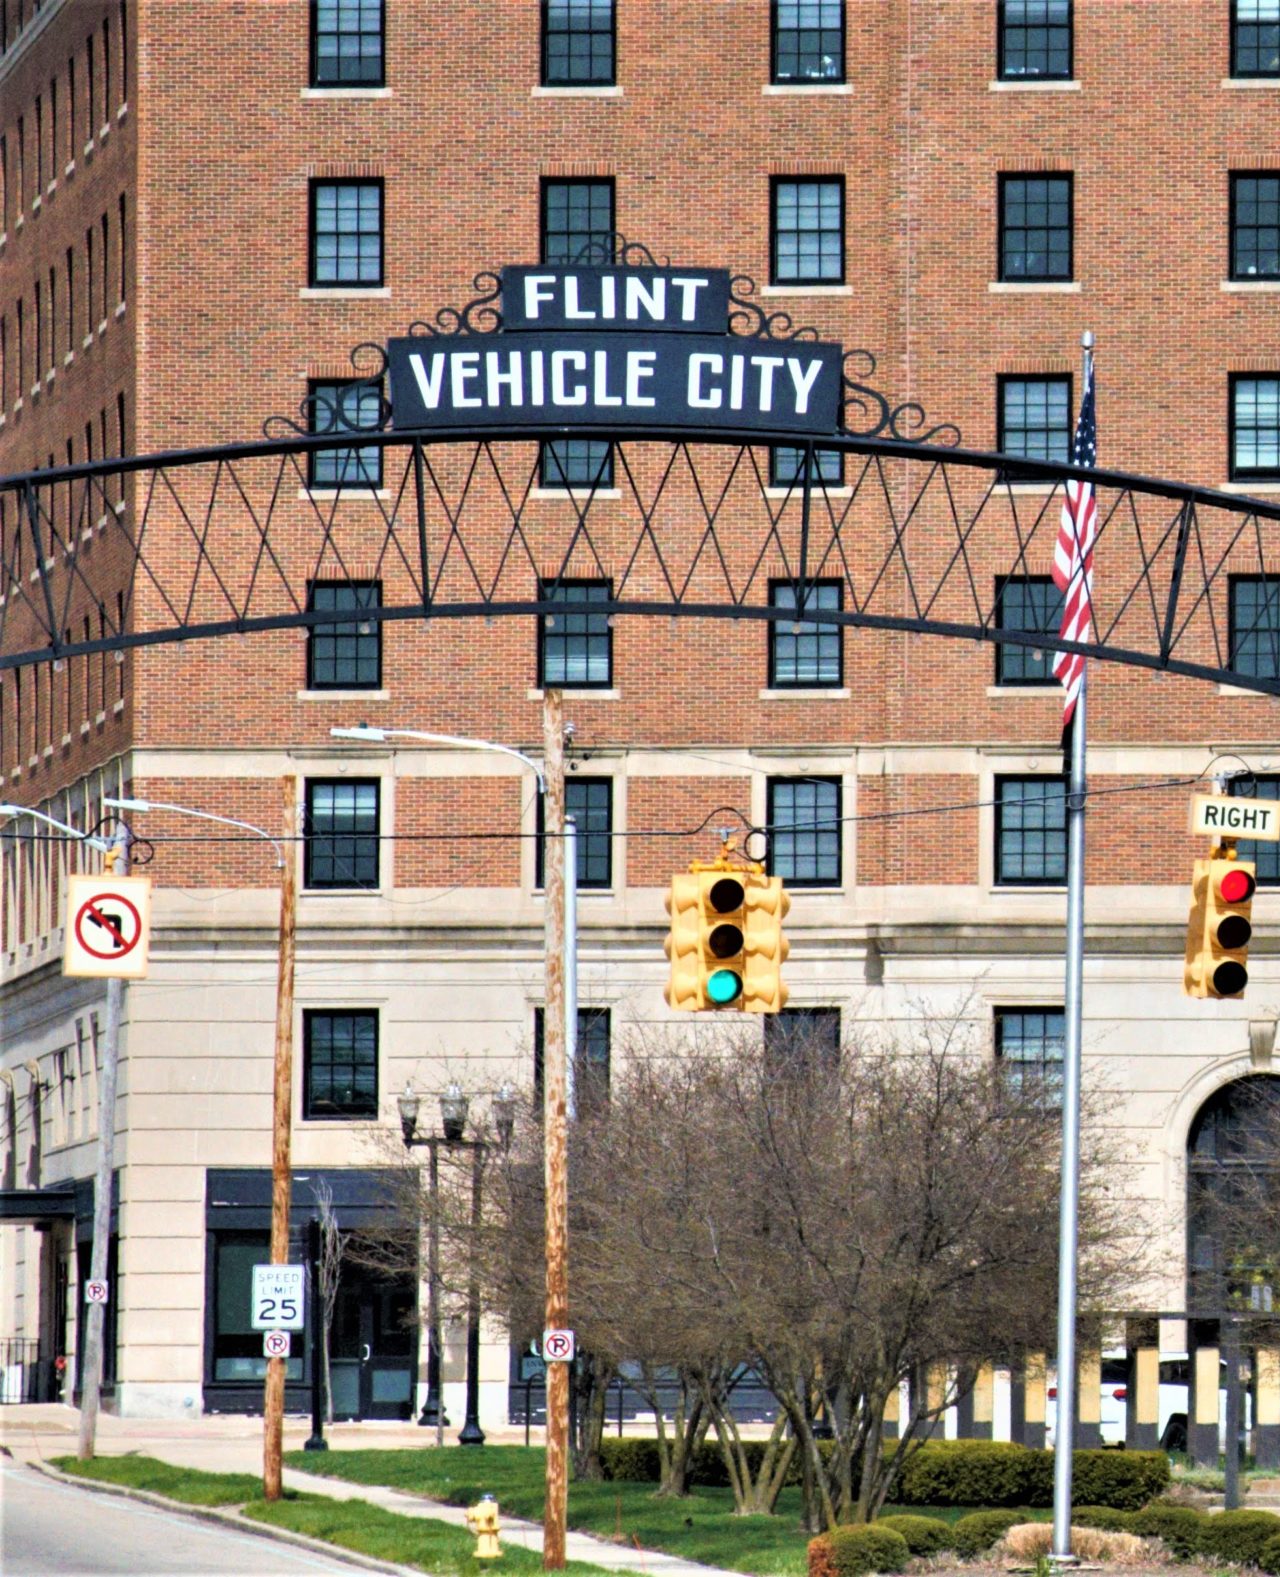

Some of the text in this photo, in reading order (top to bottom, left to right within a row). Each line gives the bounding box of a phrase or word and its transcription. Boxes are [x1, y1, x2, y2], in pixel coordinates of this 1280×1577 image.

[524, 274, 709, 321] FLINT
[408, 350, 823, 414] VEHICLE CITY
[1204, 805, 1271, 830] RIGHT
[258, 1273, 299, 1283] SPEED
[262, 1286, 294, 1296] LIMIT
[259, 1299, 297, 1320] 25
